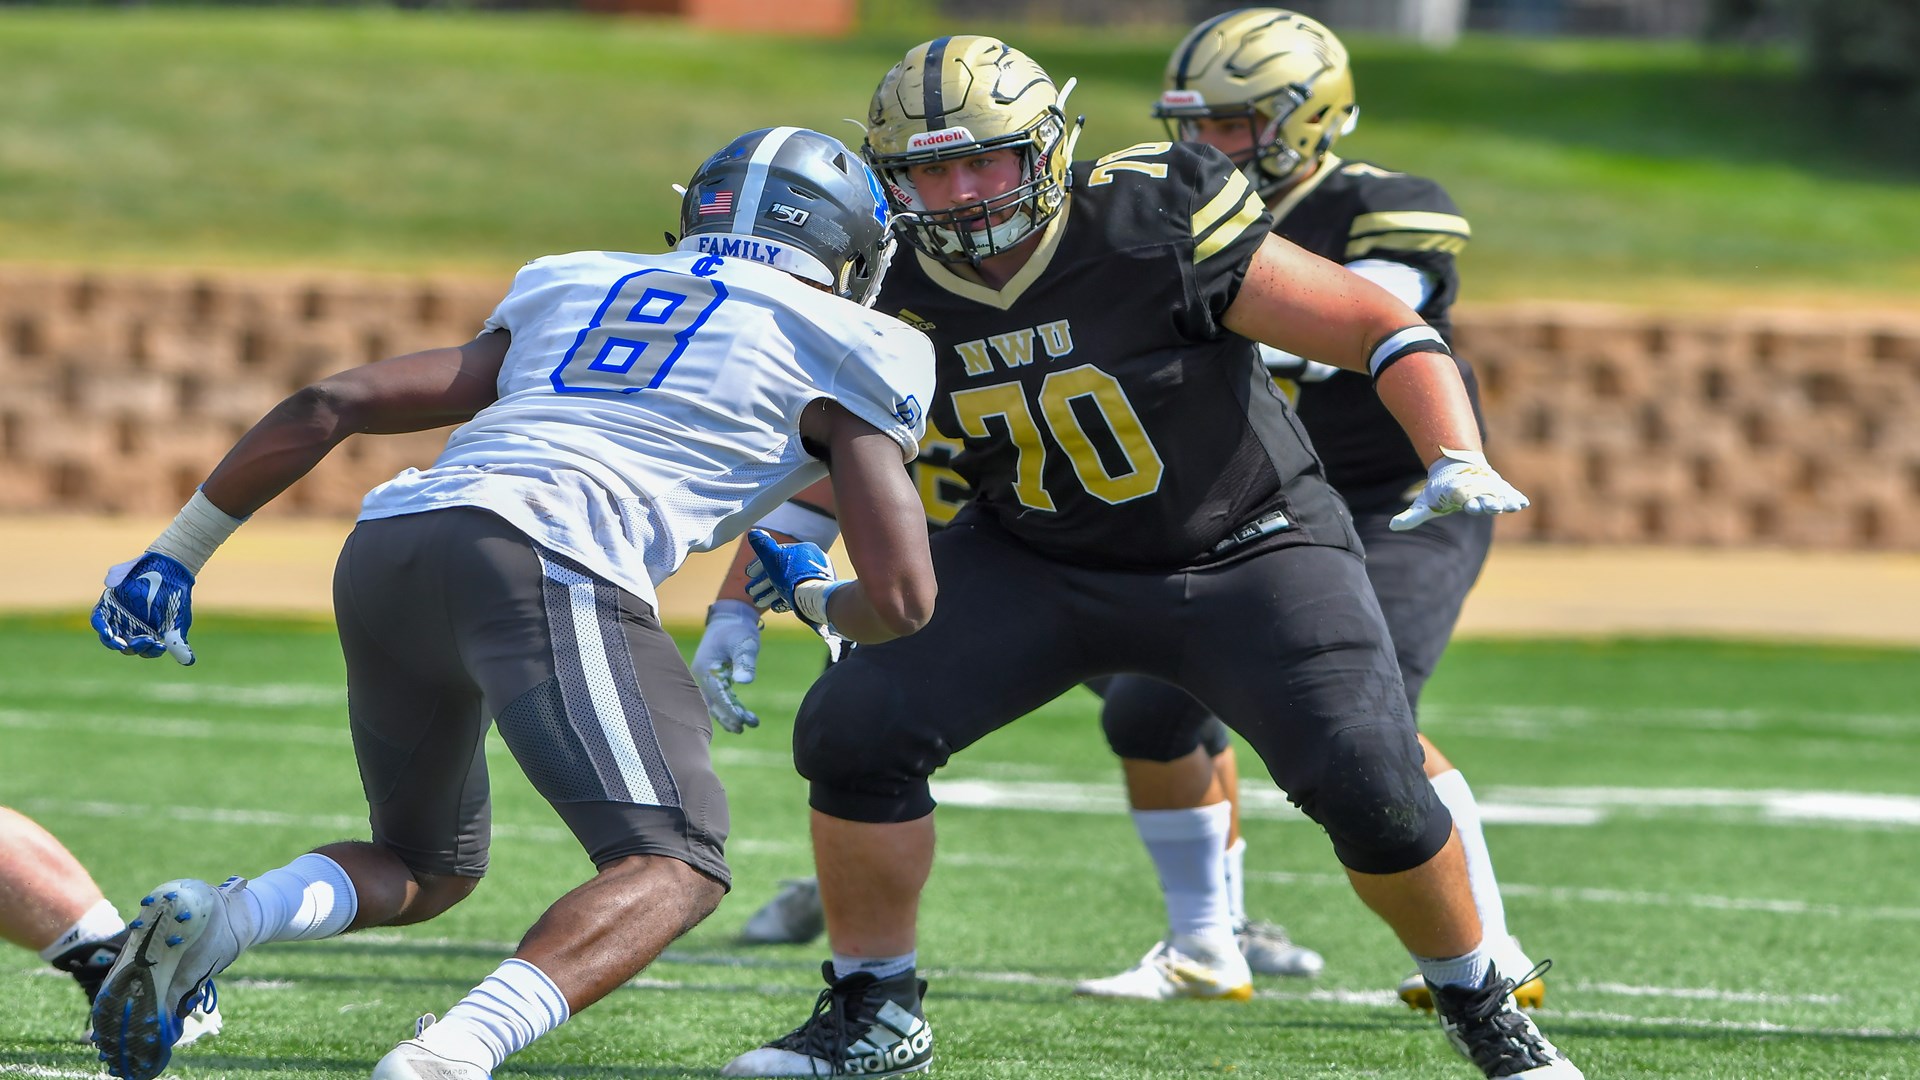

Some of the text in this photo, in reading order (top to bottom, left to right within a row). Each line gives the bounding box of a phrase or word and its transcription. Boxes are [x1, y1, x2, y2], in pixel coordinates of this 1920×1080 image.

[1088, 141, 1173, 187] 70
[771, 203, 810, 226] 150
[699, 237, 781, 265] FAMILY
[550, 268, 729, 394] 8
[954, 319, 1074, 376] NWU
[950, 363, 1165, 512] 70
